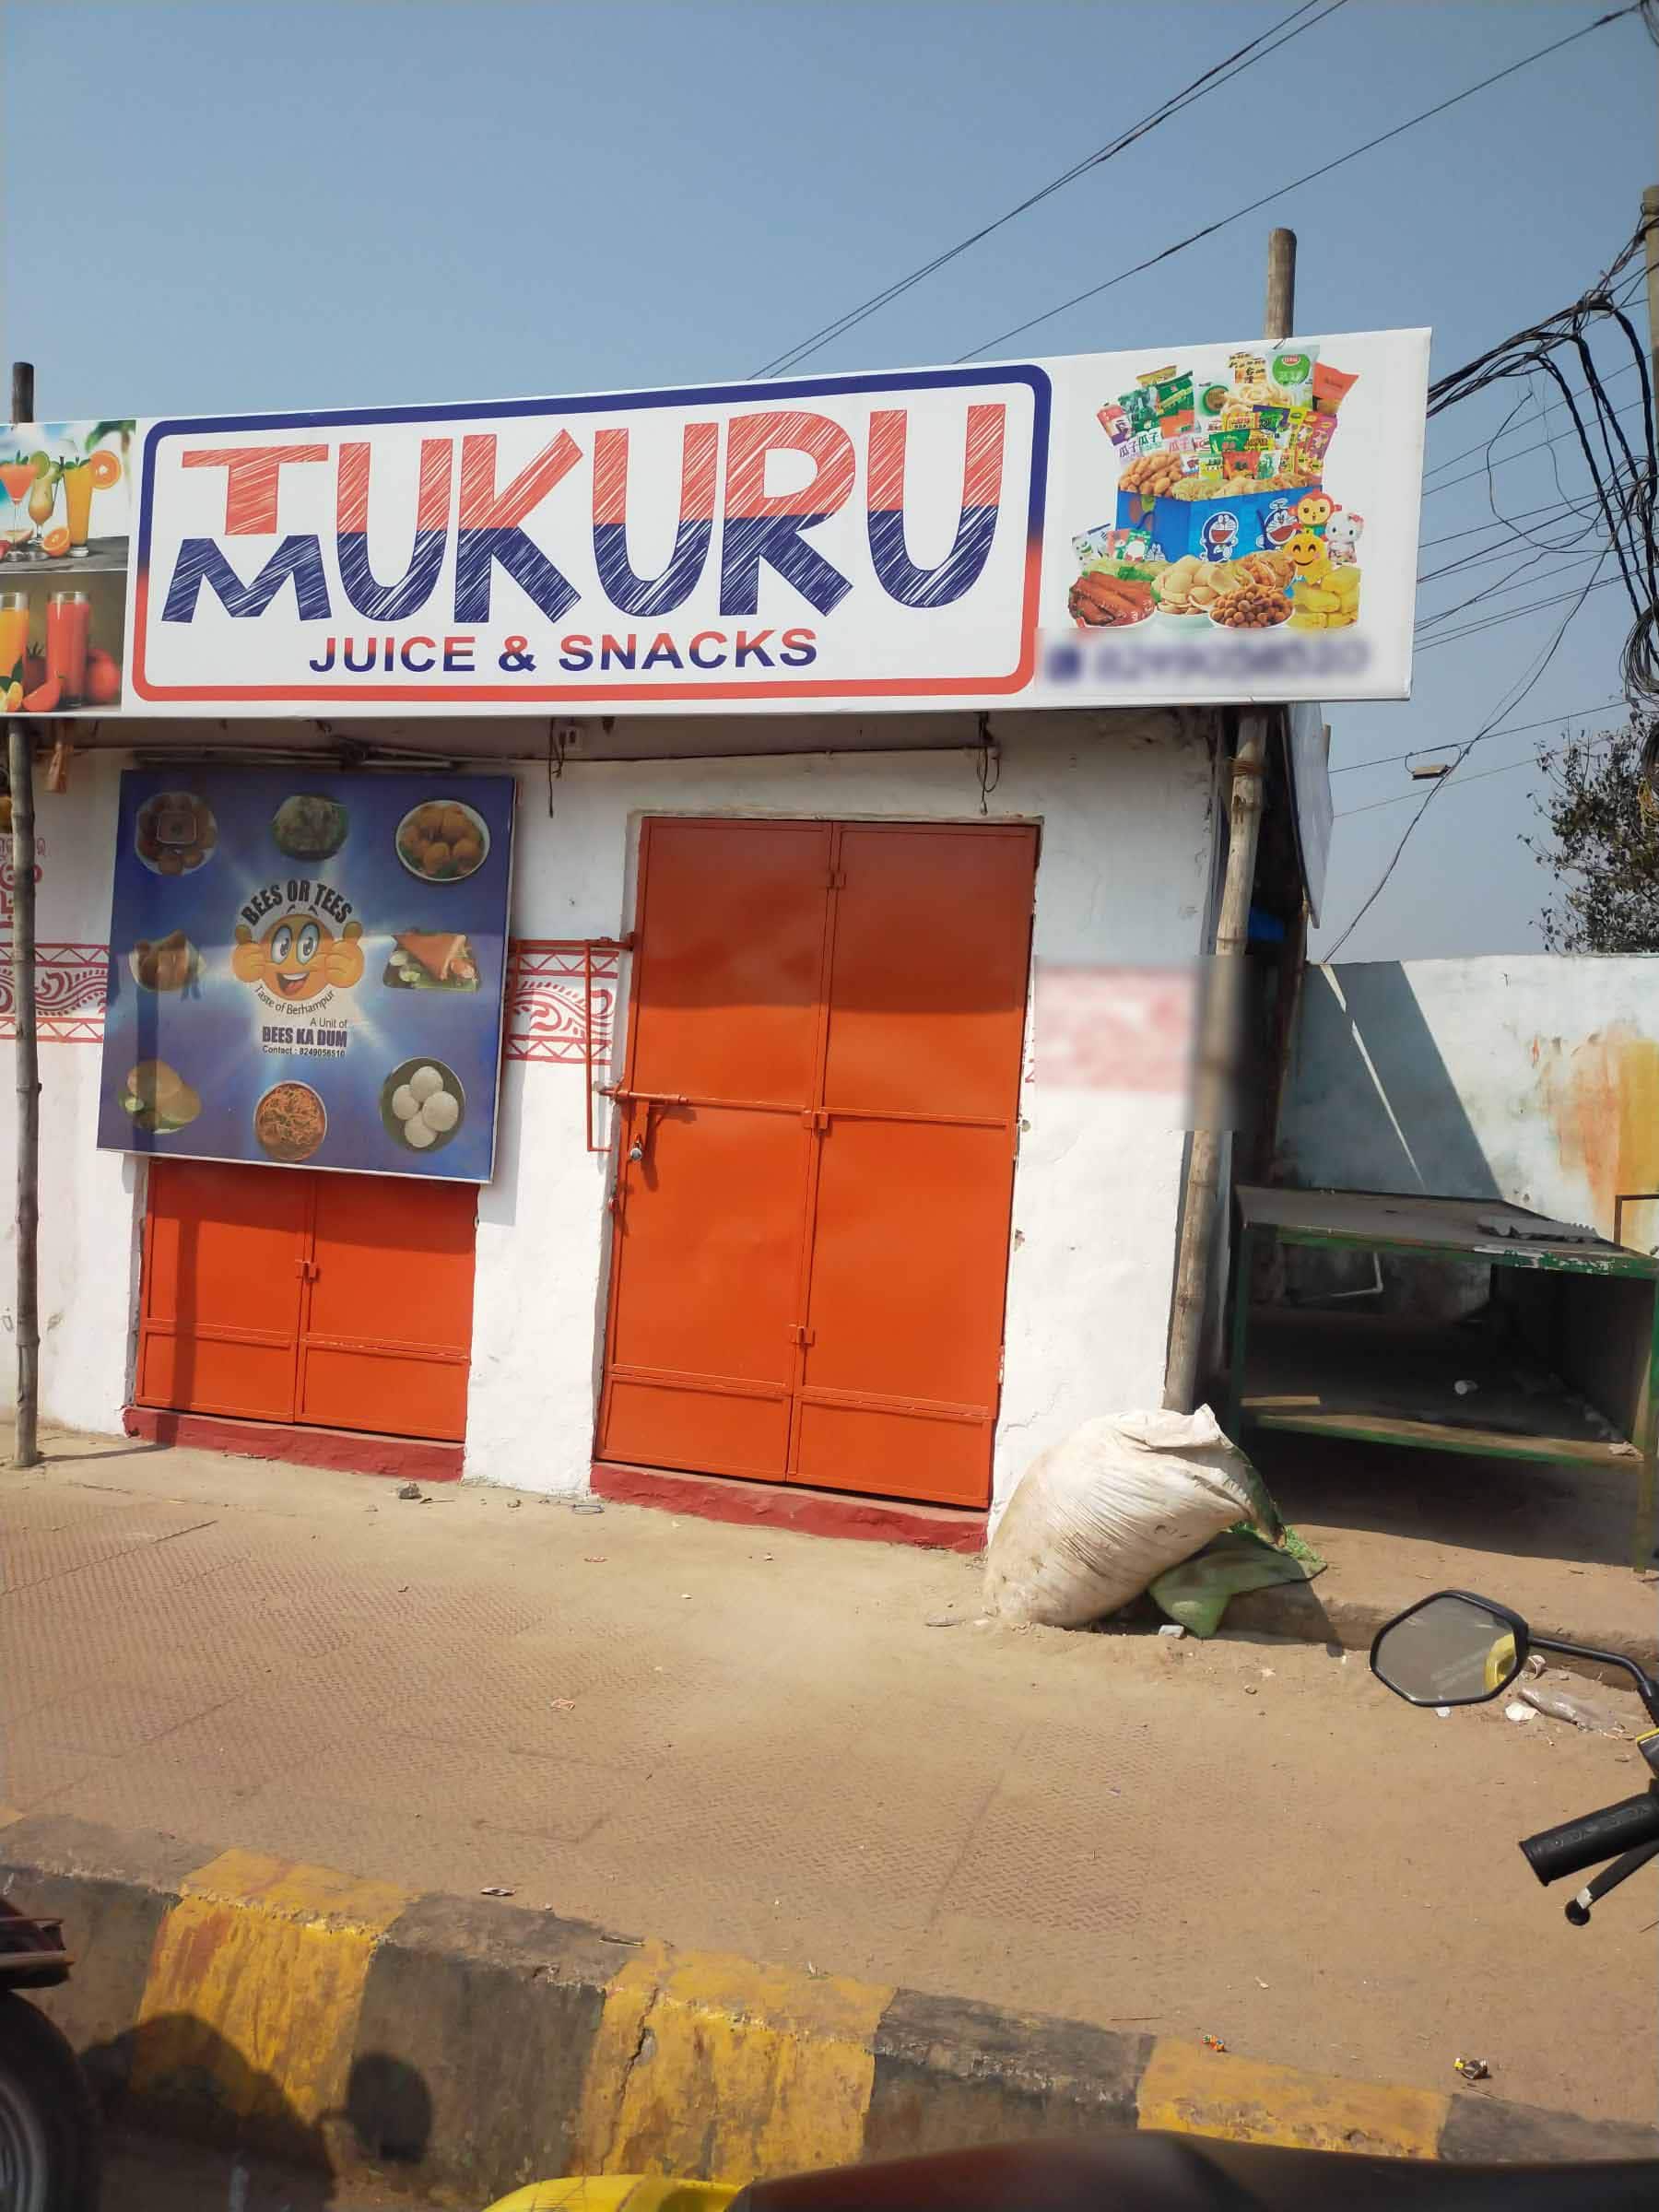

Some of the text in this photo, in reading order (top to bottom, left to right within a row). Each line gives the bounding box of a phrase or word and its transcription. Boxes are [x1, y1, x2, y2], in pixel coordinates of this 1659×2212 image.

[309, 628, 818, 673] JUICE & SNACKS
[241, 879, 353, 926] BEES OR TEES
[254, 983, 335, 1015] Taste of Berhampur
[262, 1026, 347, 1048] BEES KA DUM
[310, 1018, 347, 1029] A Unit of
[262, 1045, 292, 1055] Contact
